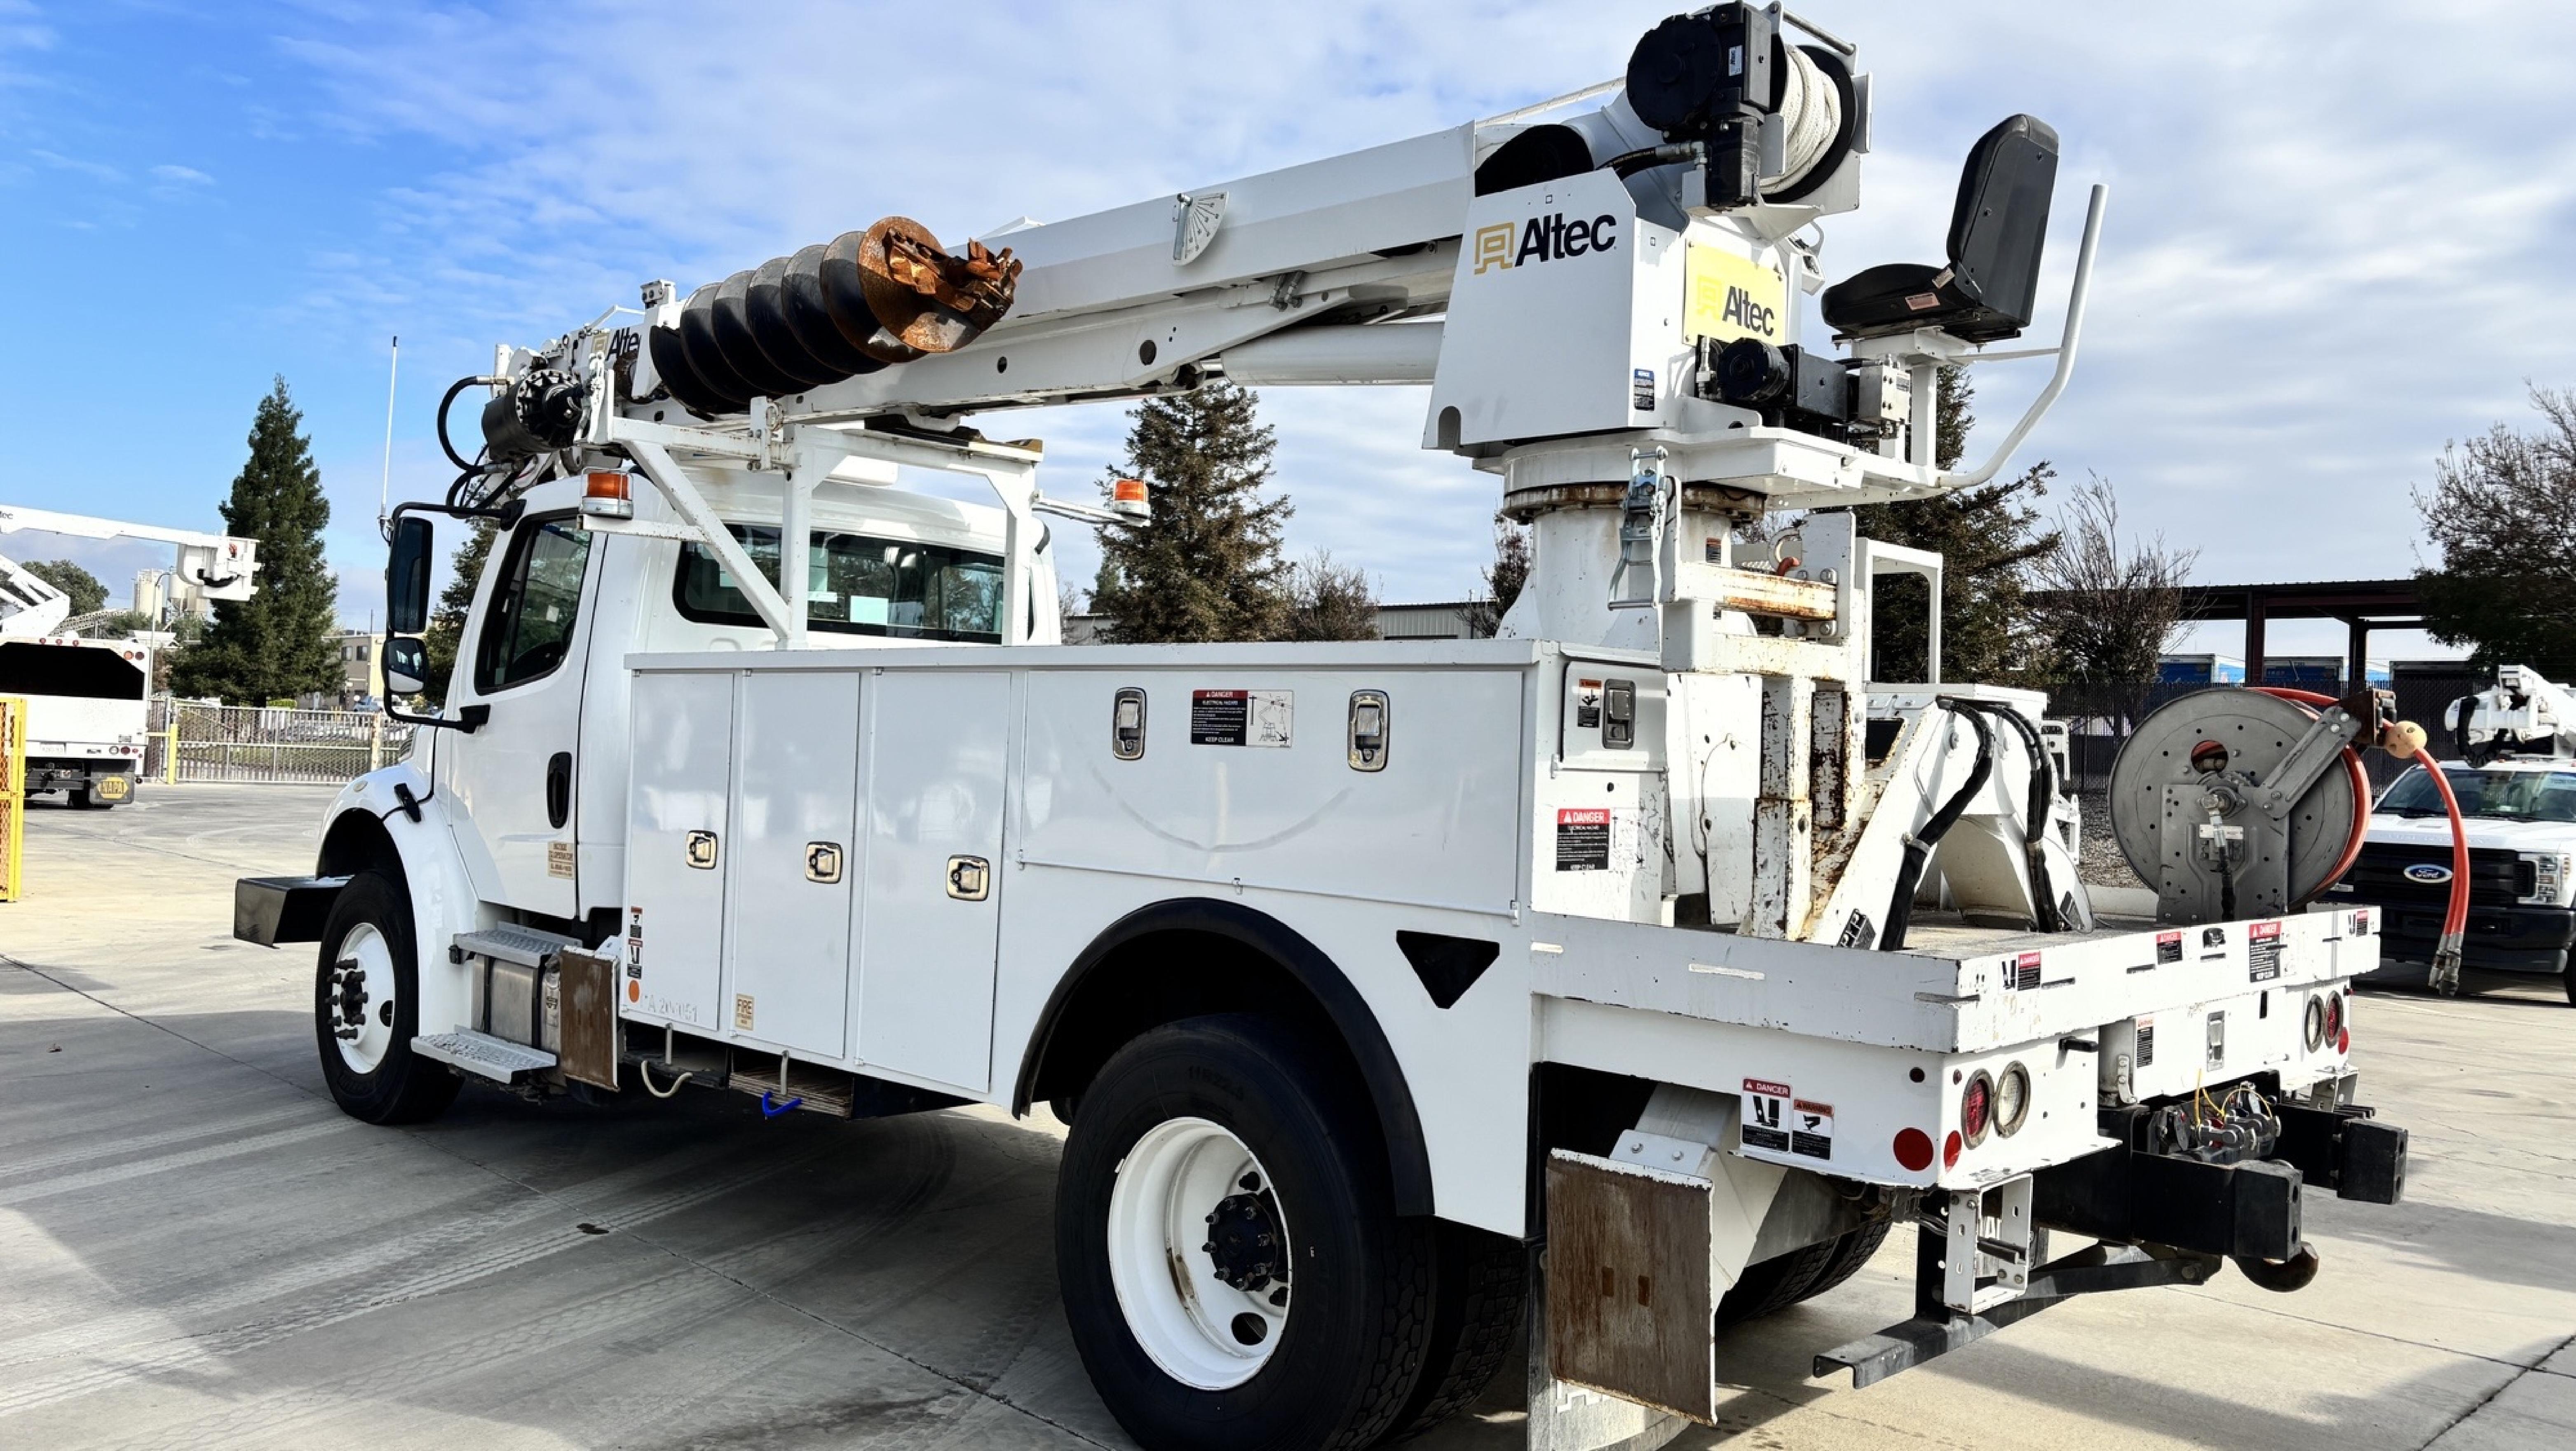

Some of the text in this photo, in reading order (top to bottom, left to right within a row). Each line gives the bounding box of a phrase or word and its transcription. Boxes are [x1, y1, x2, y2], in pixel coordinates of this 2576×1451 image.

[1514, 212, 1617, 267] Altec
[1722, 285, 1774, 337] Altec
[605, 327, 642, 361] Alte
[1572, 811, 1605, 823] DANGER
[737, 999, 752, 1015] FIRE
[1756, 1082, 1789, 1095] DANGER
